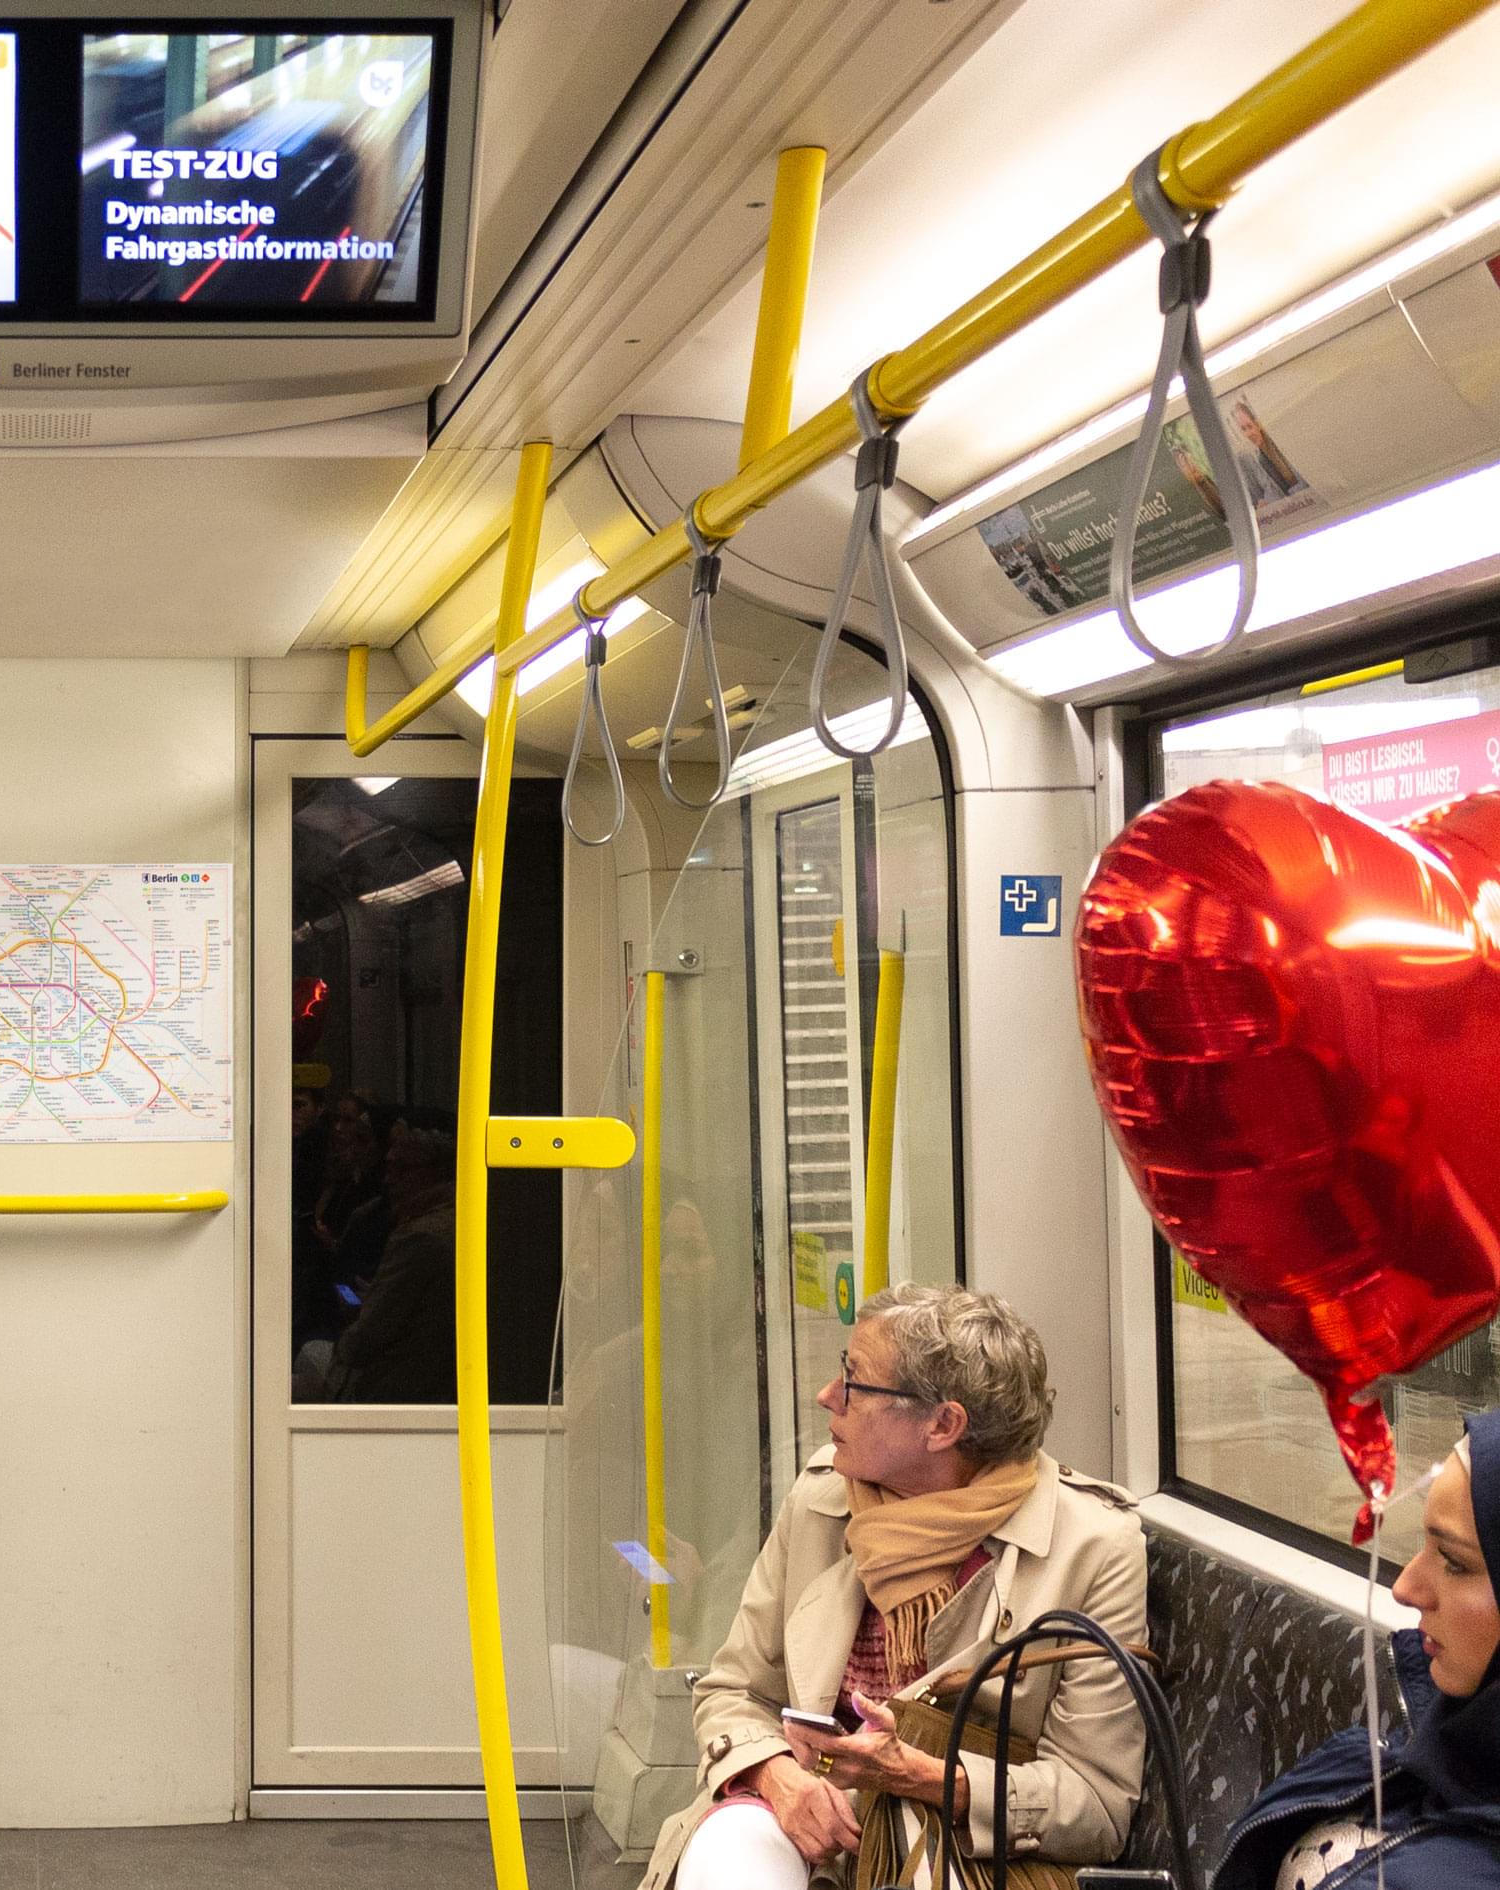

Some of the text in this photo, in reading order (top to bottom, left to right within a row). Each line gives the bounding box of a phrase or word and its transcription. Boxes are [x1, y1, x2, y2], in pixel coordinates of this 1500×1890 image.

[108, 150, 277, 180] TEST-ZUG
[106, 200, 275, 230] Dynamische
[106, 235, 394, 266] Fahrgastinformation
[12, 362, 131, 378] Berliner Fenster
[1047, 540, 1070, 561] Du
[1066, 521, 1101, 553] willst
[1328, 739, 1426, 779] DU BIST LESBISCH.
[1373, 775, 1395, 803] NUR
[1399, 773, 1413, 799] ZU
[1415, 765, 1460, 796] HAUSE?
[151, 873, 178, 883] Berlin
